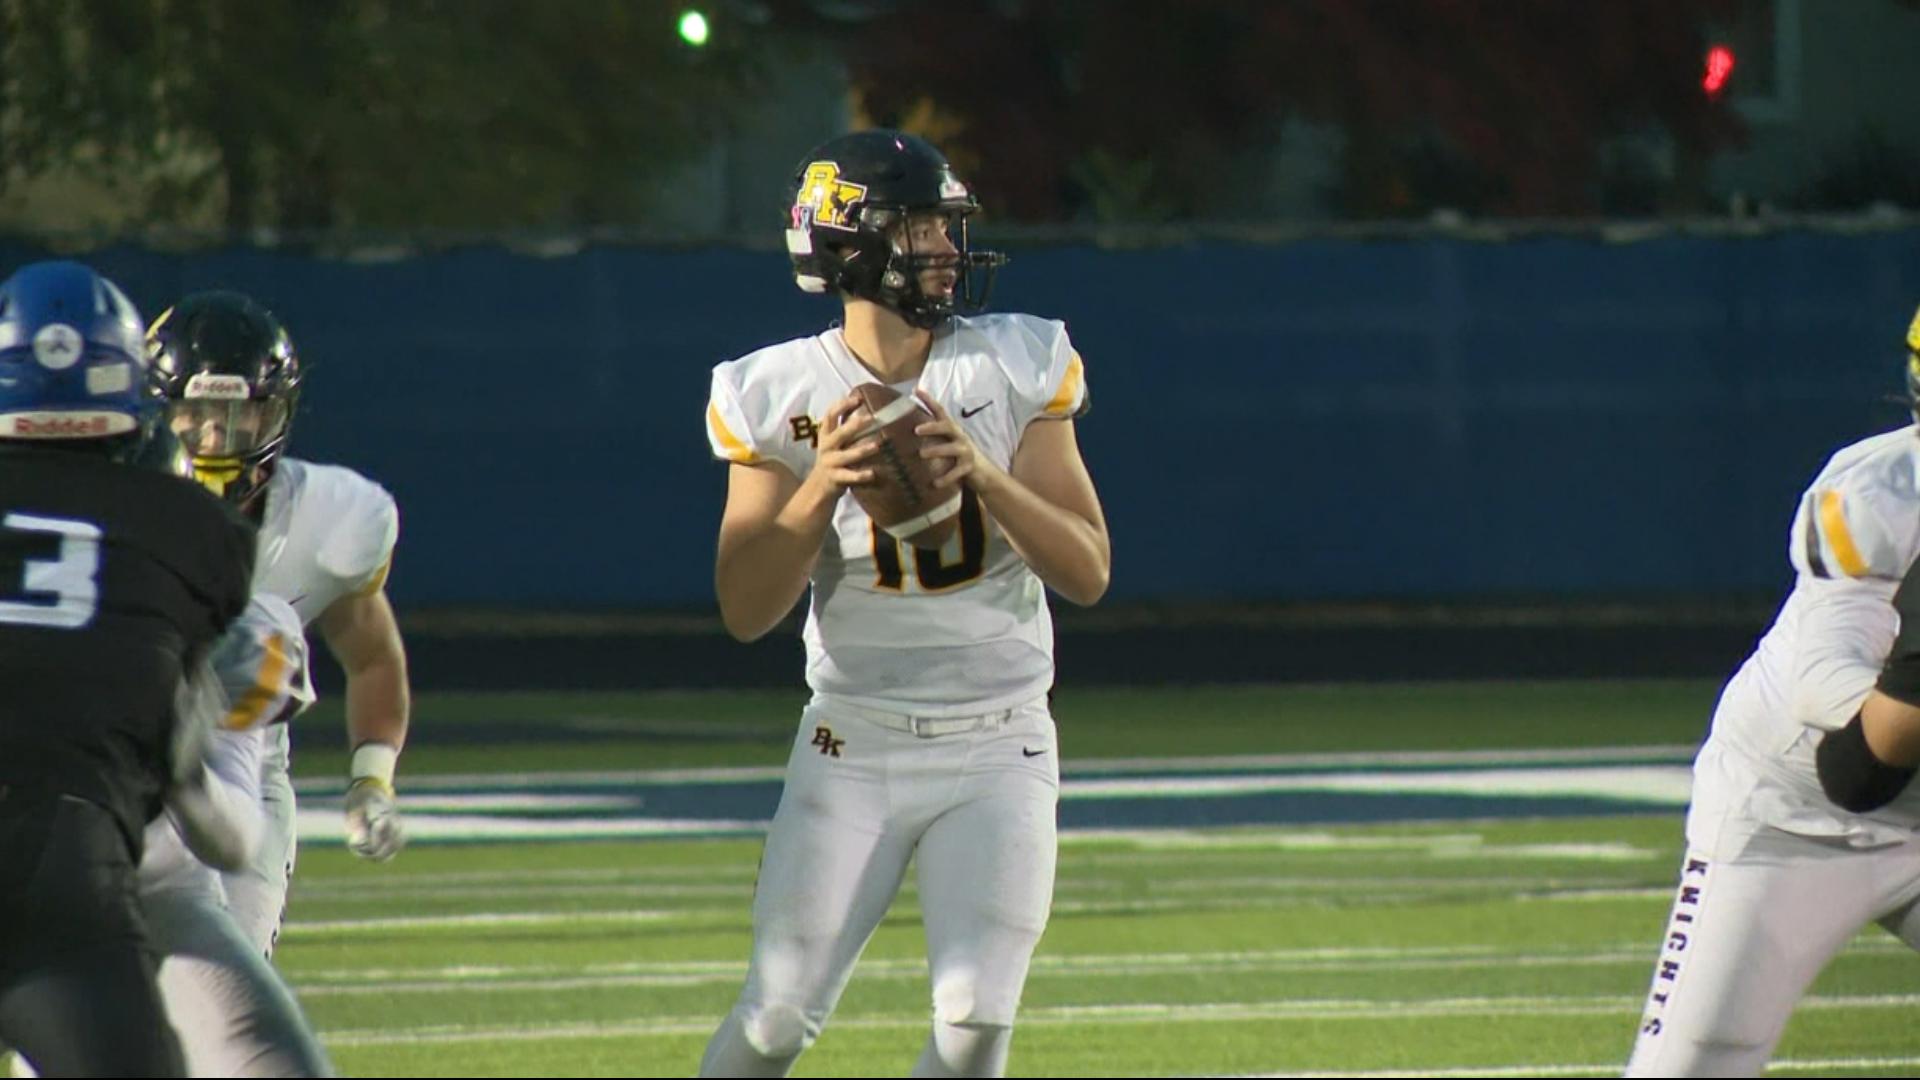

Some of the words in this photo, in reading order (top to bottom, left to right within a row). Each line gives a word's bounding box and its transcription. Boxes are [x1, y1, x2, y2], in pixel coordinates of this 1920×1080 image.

[14, 416, 109, 434] Riddell
[0, 513, 101, 628] 3
[811, 726, 846, 758] BK
[1644, 858, 1709, 1036] KNIGHTS
